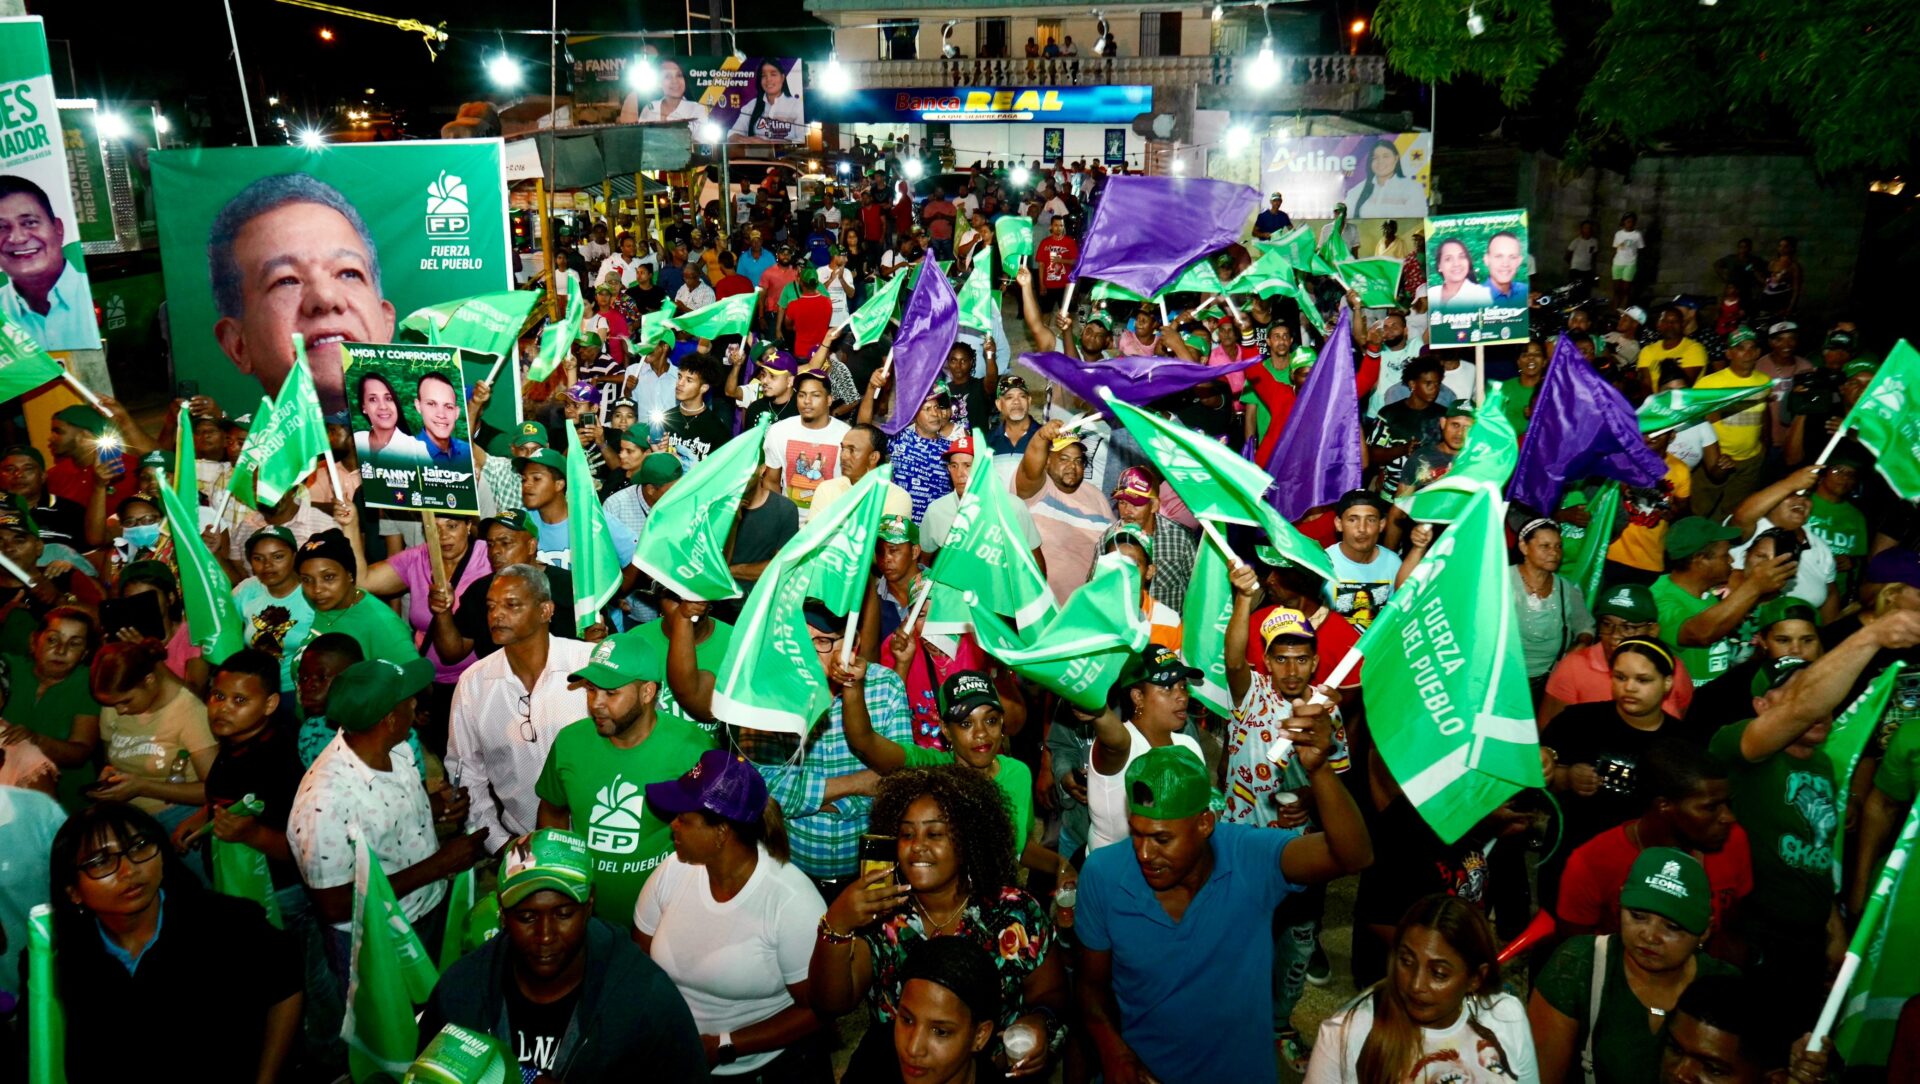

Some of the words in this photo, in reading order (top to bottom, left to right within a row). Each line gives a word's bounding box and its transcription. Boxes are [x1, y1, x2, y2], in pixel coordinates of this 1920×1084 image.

[586, 59, 627, 72] FANNY
[690, 69, 709, 78] Que
[710, 69, 754, 78] Gobiernen
[697, 78, 713, 86] Las
[714, 78, 748, 88] Mujeres
[0, 84, 37, 130] ES
[896, 93, 960, 110] Banca
[964, 91, 1063, 111] REAL
[757, 118, 791, 130] Arline
[1268, 147, 1357, 173] Arline
[77, 150, 98, 223] PRESIDENTE
[430, 218, 465, 231] FP
[431, 245, 470, 257] FUERZA
[420, 258, 439, 270] DEL
[441, 258, 482, 270] PUEBLO
[349, 348, 376, 358] AMOR
[376, 350, 384, 358] Y
[387, 350, 451, 361] COMPROMISO
[376, 467, 416, 481] FANNY
[422, 466, 452, 478] Jairo
[1169, 470, 1213, 484] FP
[975, 544, 1001, 567] DEL
[1263, 613, 1298, 632] Fanny
[1401, 617, 1425, 660] DEL
[1422, 596, 1466, 676] FUERZA
[1072, 660, 1105, 694] DEL
[953, 682, 988, 696] FANNY
[1409, 654, 1466, 737] PUEBLO
[1248, 720, 1265, 729] FILA
[1254, 785, 1272, 793] FILA
[547, 831, 587, 849] ERIDANIA
[591, 831, 634, 850] FP
[597, 860, 618, 873] DEL
[622, 850, 669, 874] PUEBLO
[1645, 875, 1689, 897] LEONEL
[440, 1023, 490, 1054] ERIDANIA
